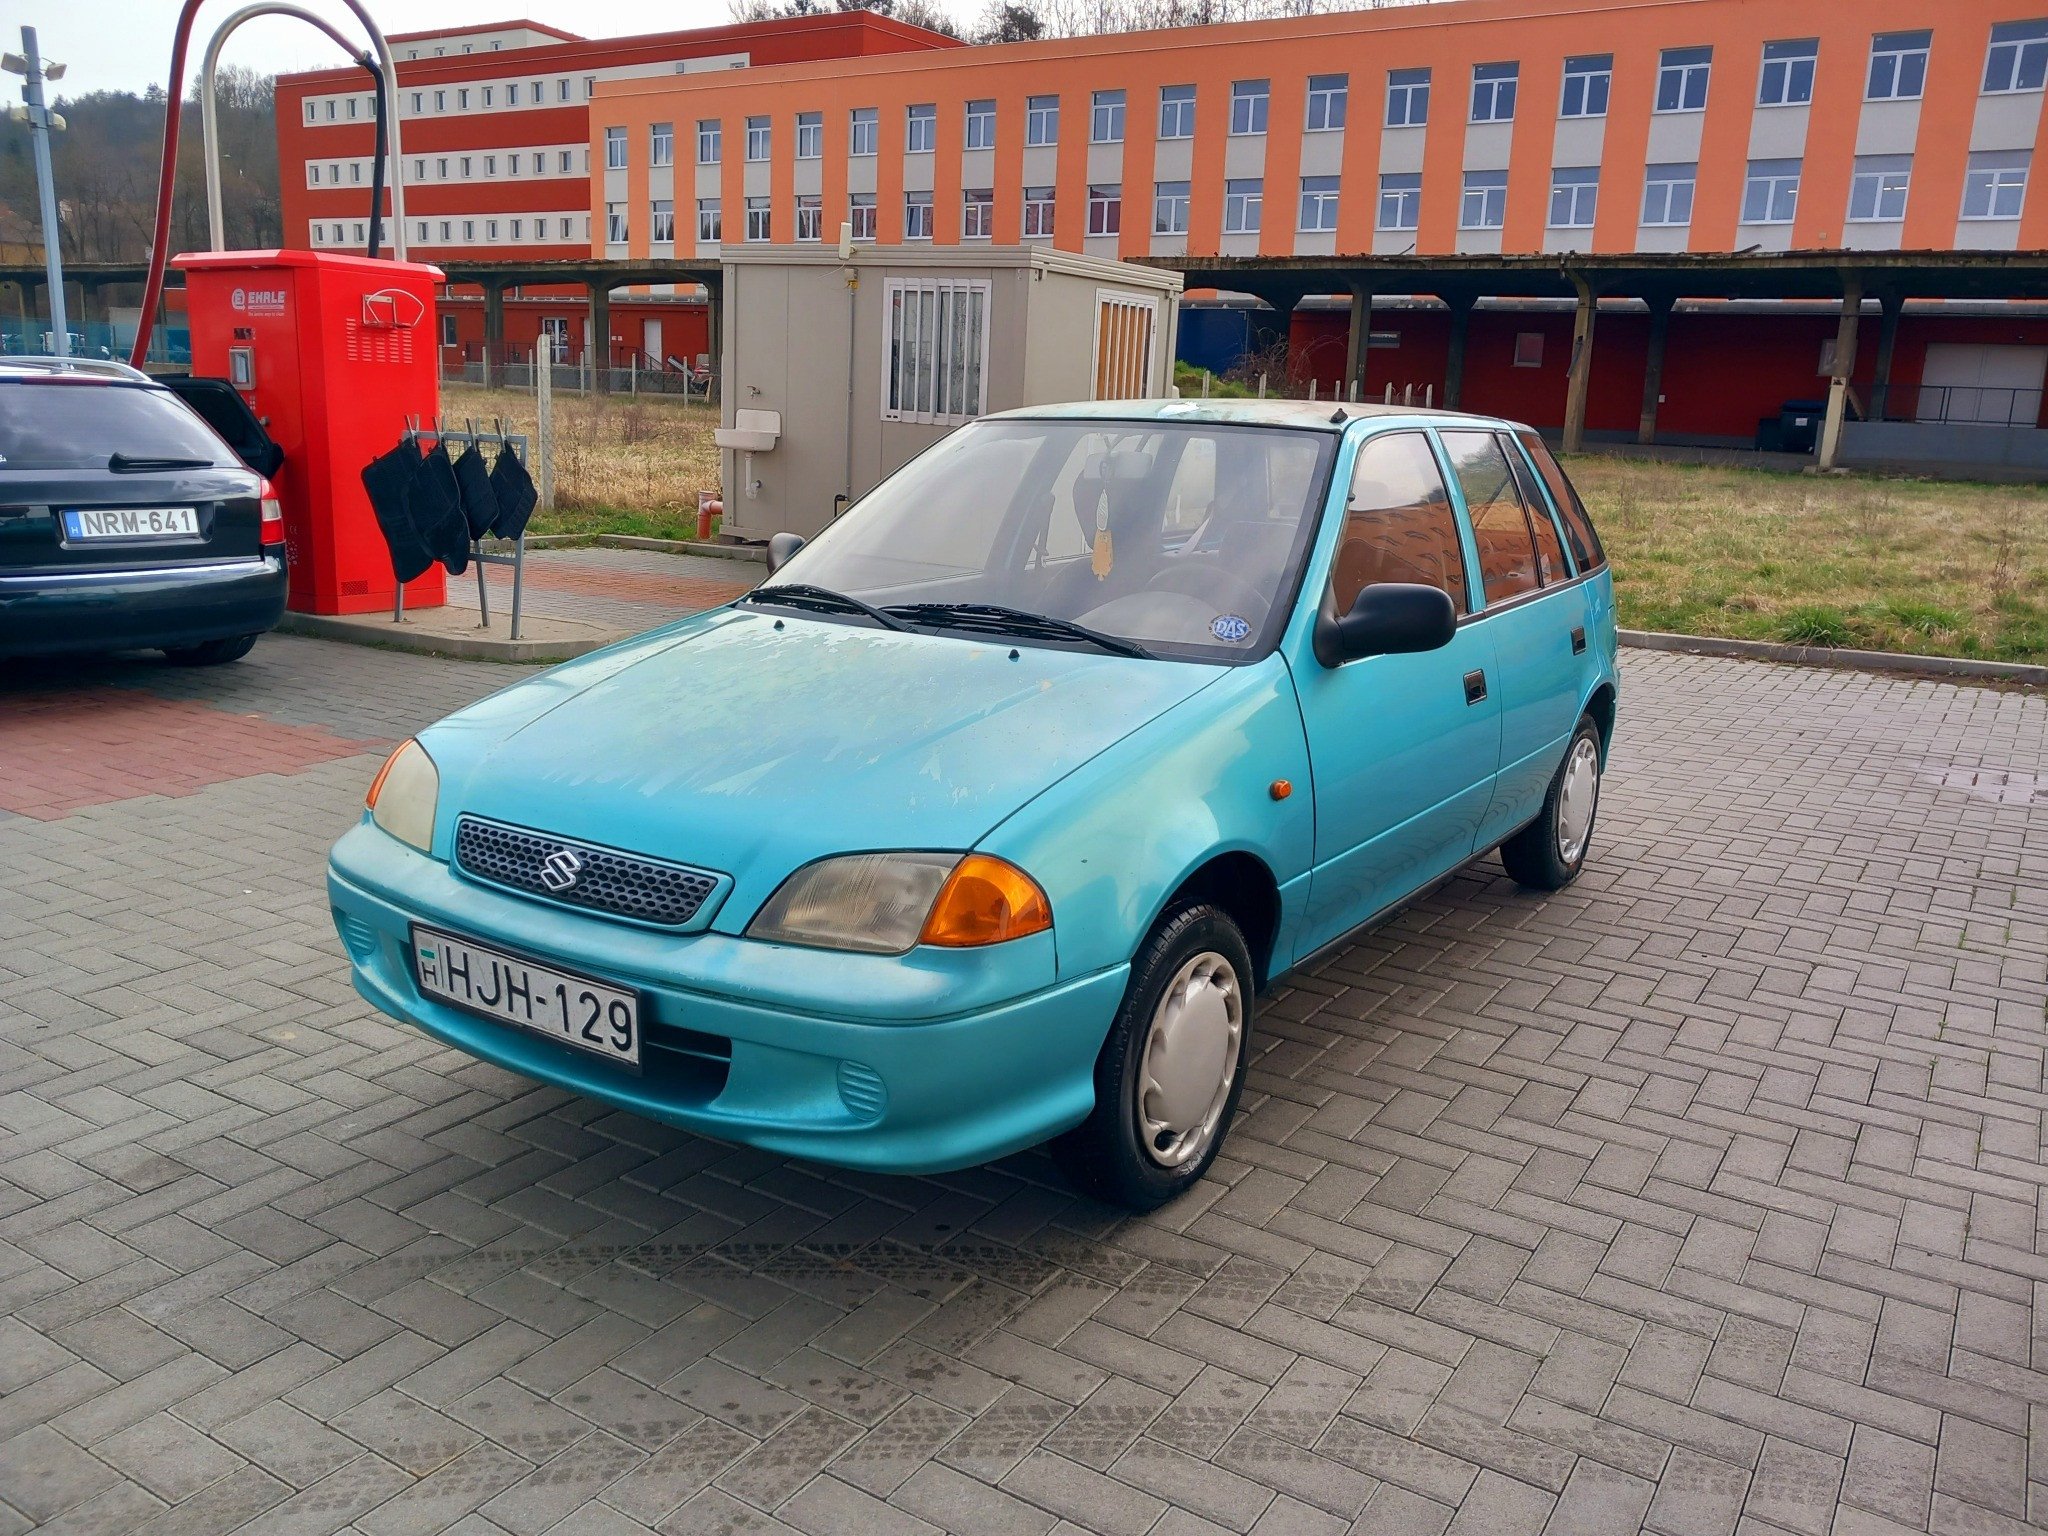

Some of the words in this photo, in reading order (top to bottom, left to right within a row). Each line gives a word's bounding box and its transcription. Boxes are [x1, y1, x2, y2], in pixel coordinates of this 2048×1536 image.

[84, 510, 191, 535] NRM-641
[421, 961, 438, 986] H
[446, 945, 633, 1052] HJH-129
